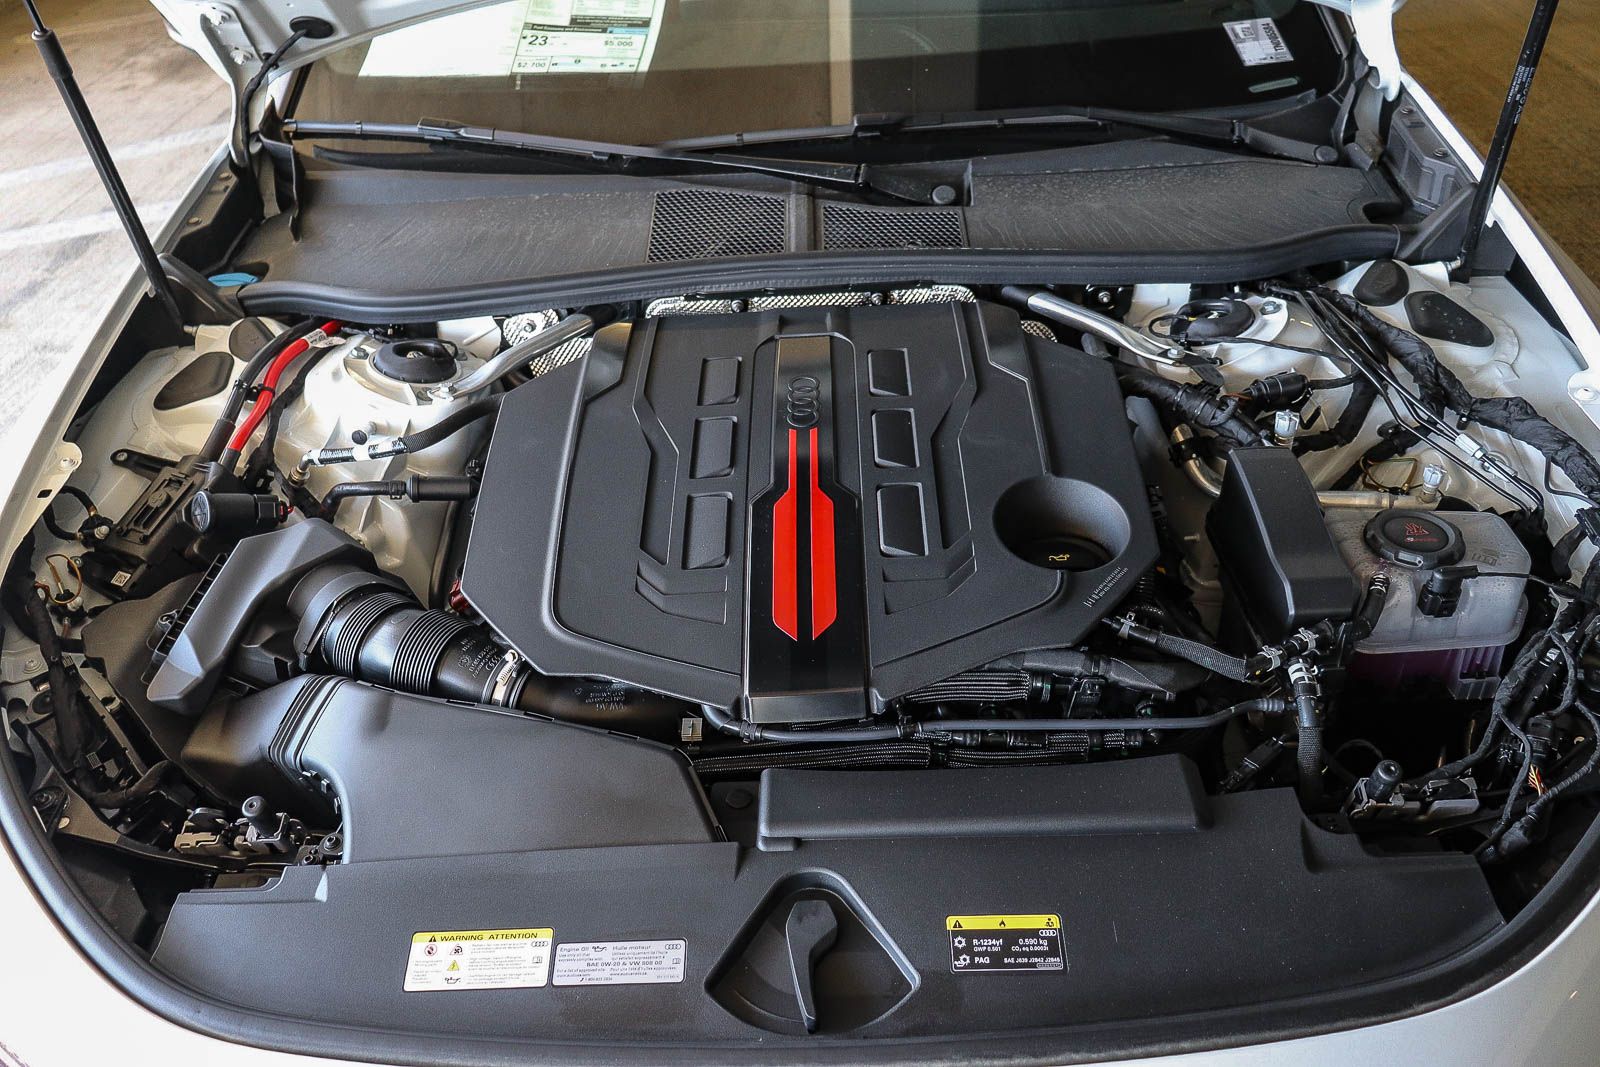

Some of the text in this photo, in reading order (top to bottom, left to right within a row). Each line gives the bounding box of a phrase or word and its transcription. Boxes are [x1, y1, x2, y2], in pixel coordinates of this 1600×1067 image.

[528, 34, 549, 46] 23
[488, 932, 538, 940] ATTENTION
[972, 938, 1003, 946] R-1234yf
[1039, 938, 1048, 946] kg
[974, 956, 990, 964] PAG
